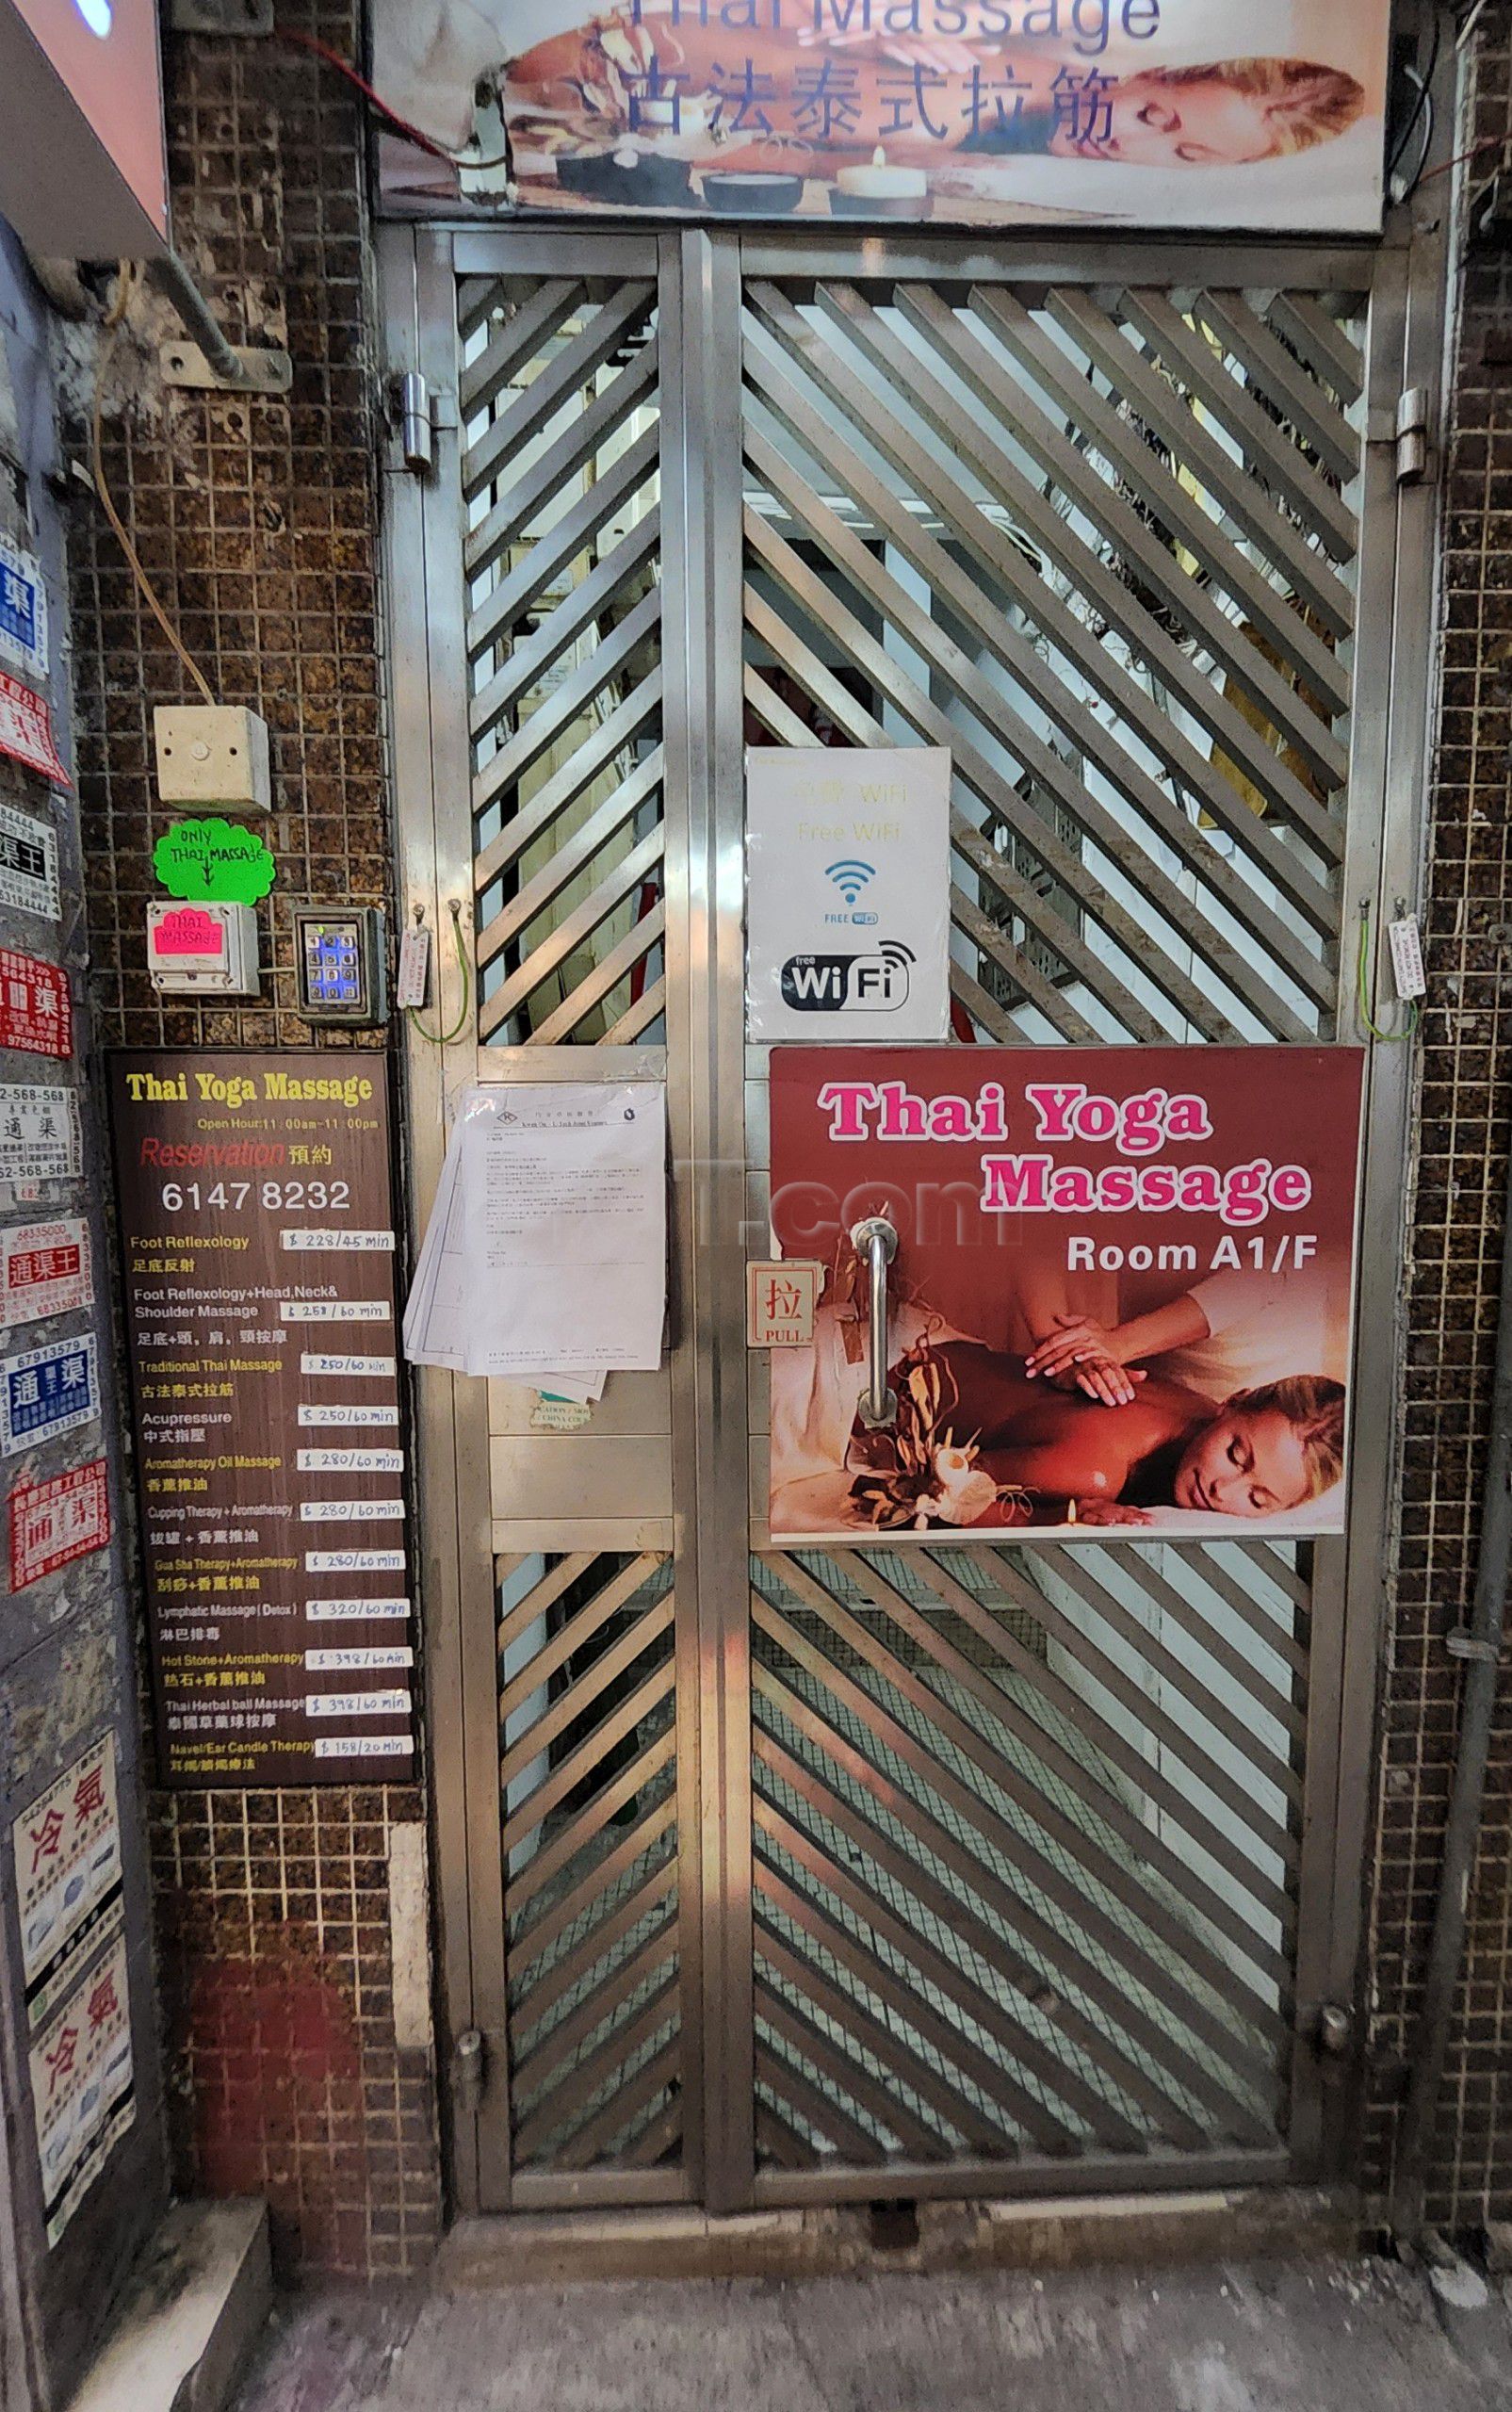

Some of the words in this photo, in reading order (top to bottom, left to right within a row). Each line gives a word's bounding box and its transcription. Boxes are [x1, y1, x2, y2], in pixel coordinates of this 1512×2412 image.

[627, 55, 1121, 145] 古法泰式拉筋
[3, 569, 32, 621] 渠
[798, 822, 845, 841] Free
[852, 822, 902, 842] WiFi
[824, 913, 849, 923] FREE
[795, 955, 816, 966] free
[126, 1072, 188, 1101] Thai
[195, 1073, 257, 1109] Yoga
[264, 1072, 373, 1108] Massage
[197, 1118, 228, 1130] Open
[819, 1083, 1008, 1141] Thai
[1026, 1084, 1213, 1155] Yoga
[140, 1137, 285, 1167] Reservation
[288, 1143, 333, 1166] 預約
[161, 1182, 252, 1212] 6147
[262, 1181, 350, 1210] 8232
[981, 1154, 1312, 1225] Massage
[130, 1236, 162, 1249] Foot
[166, 1235, 249, 1251] Reflexology
[366, 1233, 389, 1248] min
[1067, 1236, 1196, 1272] Room
[1210, 1234, 1318, 1274] A1/F
[10, 1246, 78, 1287] 通渠王
[132, 1258, 196, 1273] 足底反射
[134, 1287, 165, 1301] Foot
[764, 1279, 803, 1320] 拉
[135, 1305, 194, 1319] Shoulder
[198, 1304, 258, 1320] Massage
[765, 1329, 805, 1342] PULL
[17, 1340, 80, 1368] 67913579
[138, 1360, 199, 1373] Traditional
[202, 1360, 227, 1372] Thai
[229, 1359, 283, 1373] Massage
[141, 1412, 233, 1426] Acupressure
[371, 1410, 394, 1423] min
[143, 1428, 206, 1443] 中式指壓
[145, 1457, 217, 1471] Aromatherapy
[235, 1455, 282, 1470] Massage
[376, 1449, 399, 1469] min
[148, 1506, 186, 1521] Cupping
[186, 1505, 222, 1519] Therapy
[232, 1504, 293, 1518] Aromatherapy
[377, 1504, 399, 1516] min
[162, 1654, 182, 1668] Hot
[192, 1698, 230, 1712] Herbal
[254, 1697, 305, 1711] Massage
[228, 1740, 268, 1754] Candle
